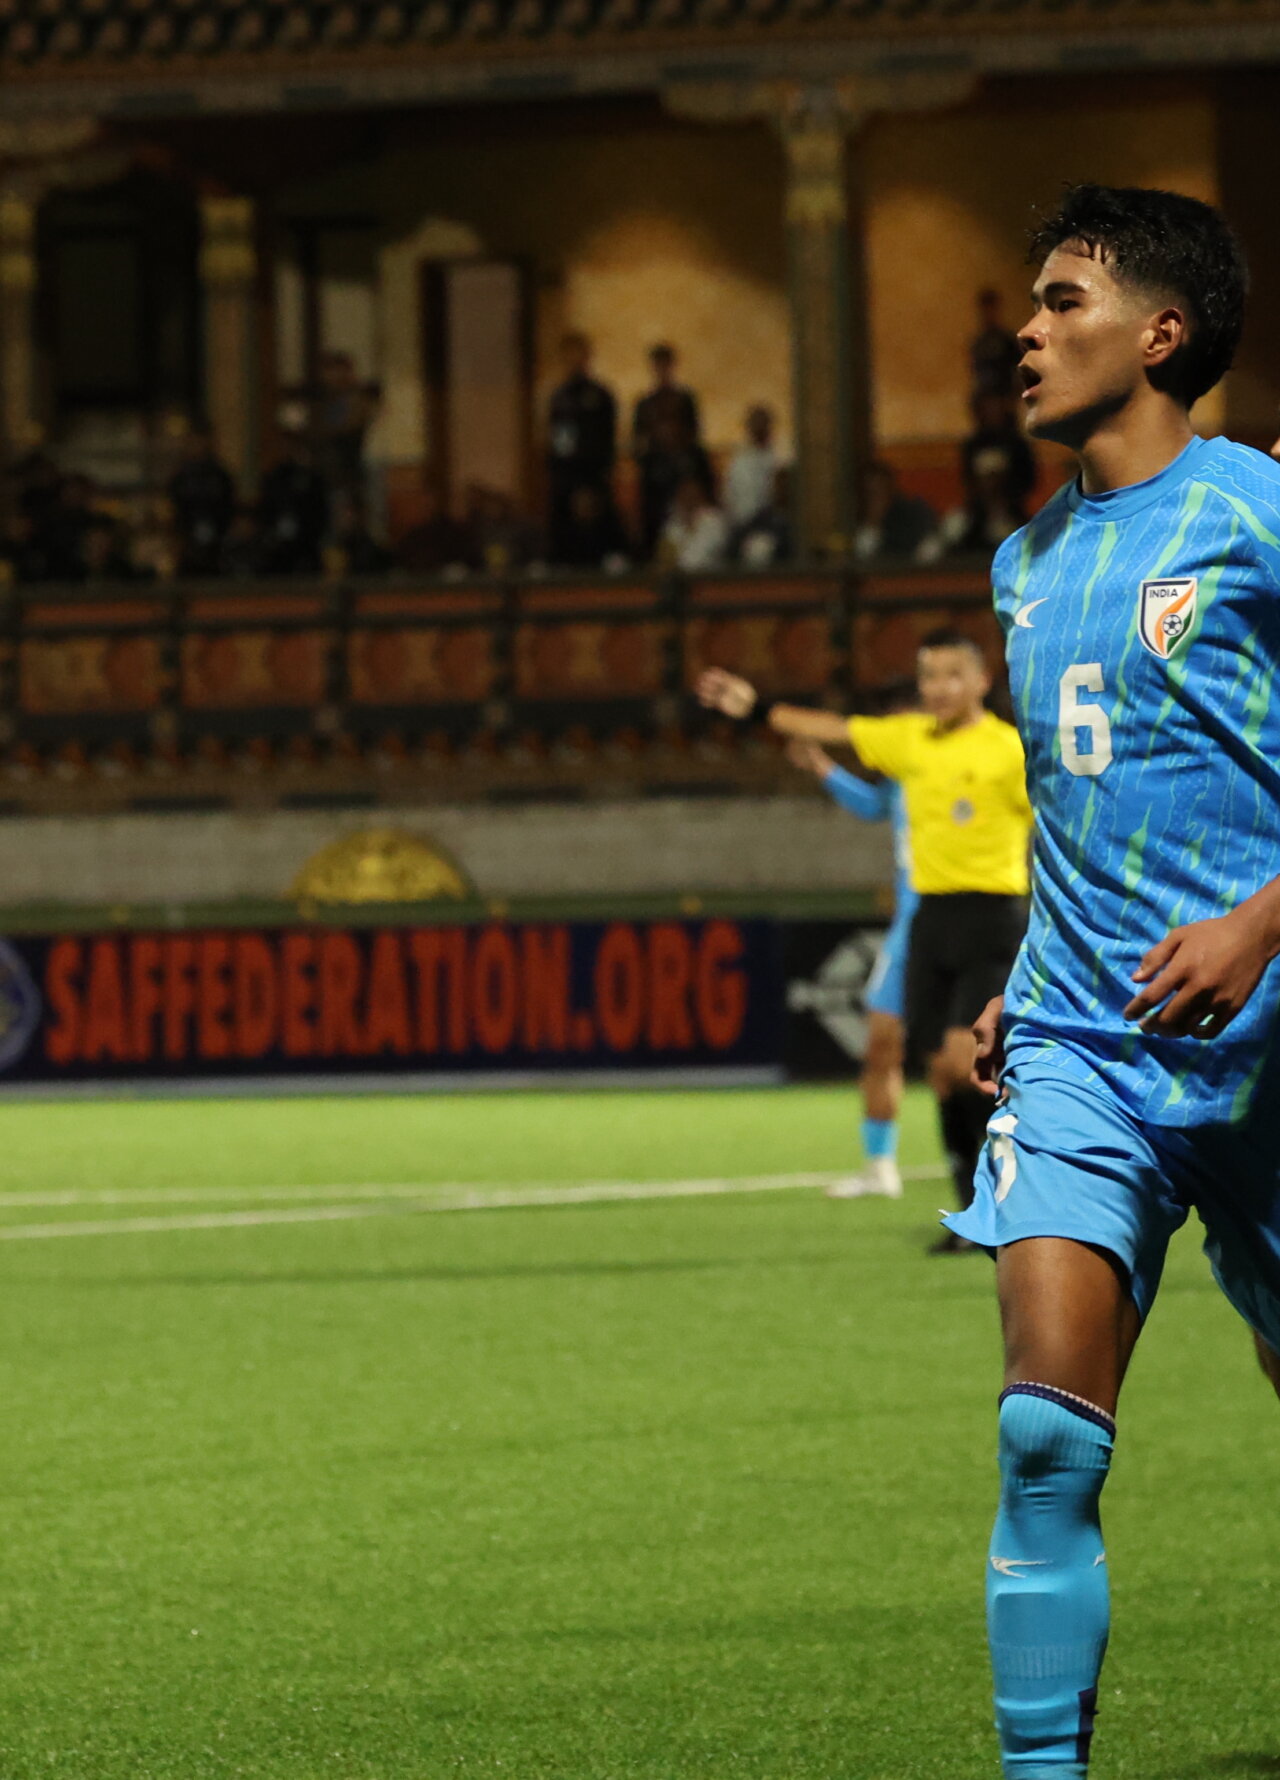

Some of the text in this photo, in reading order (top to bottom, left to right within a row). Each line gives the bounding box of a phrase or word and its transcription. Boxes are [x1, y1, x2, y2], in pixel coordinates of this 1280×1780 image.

[1150, 588, 1178, 598] INDIA
[1058, 662, 1114, 777] 6
[45, 921, 745, 1063] SAFFEDERATION.ORG
